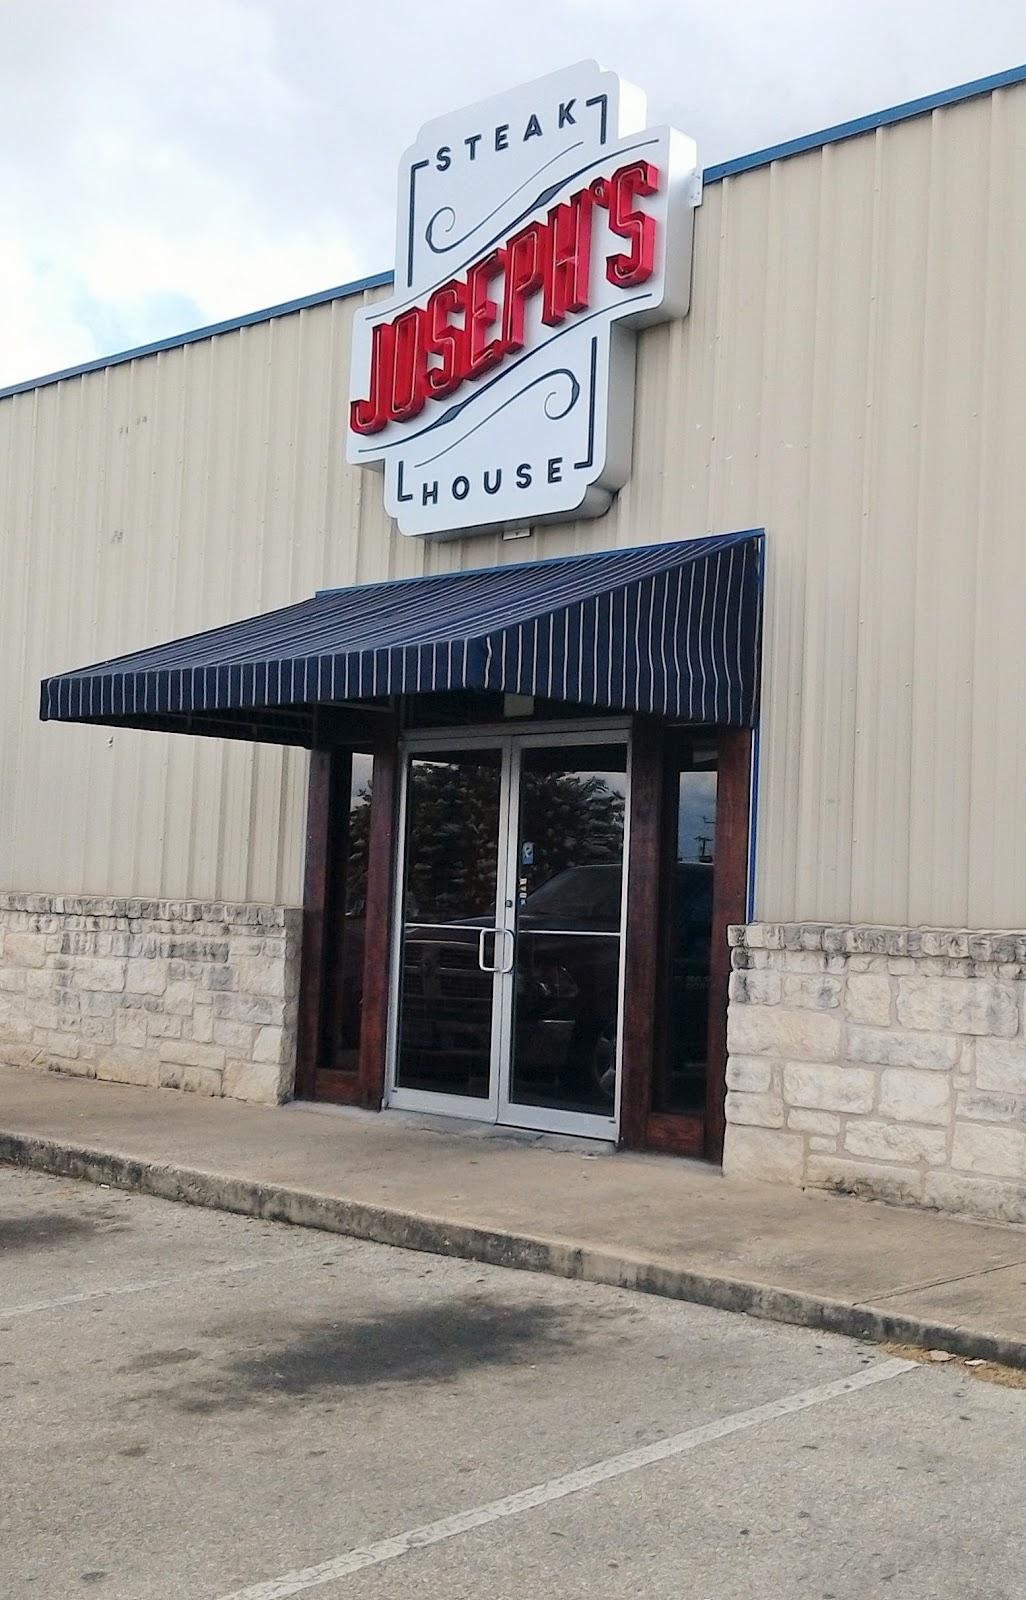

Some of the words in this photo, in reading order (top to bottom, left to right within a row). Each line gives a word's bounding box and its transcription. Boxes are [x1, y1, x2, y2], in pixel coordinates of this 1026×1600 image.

[436, 98, 577, 171] STEAK
[350, 159, 659, 435] JOSEPH'S
[422, 457, 563, 506] HOUSE
